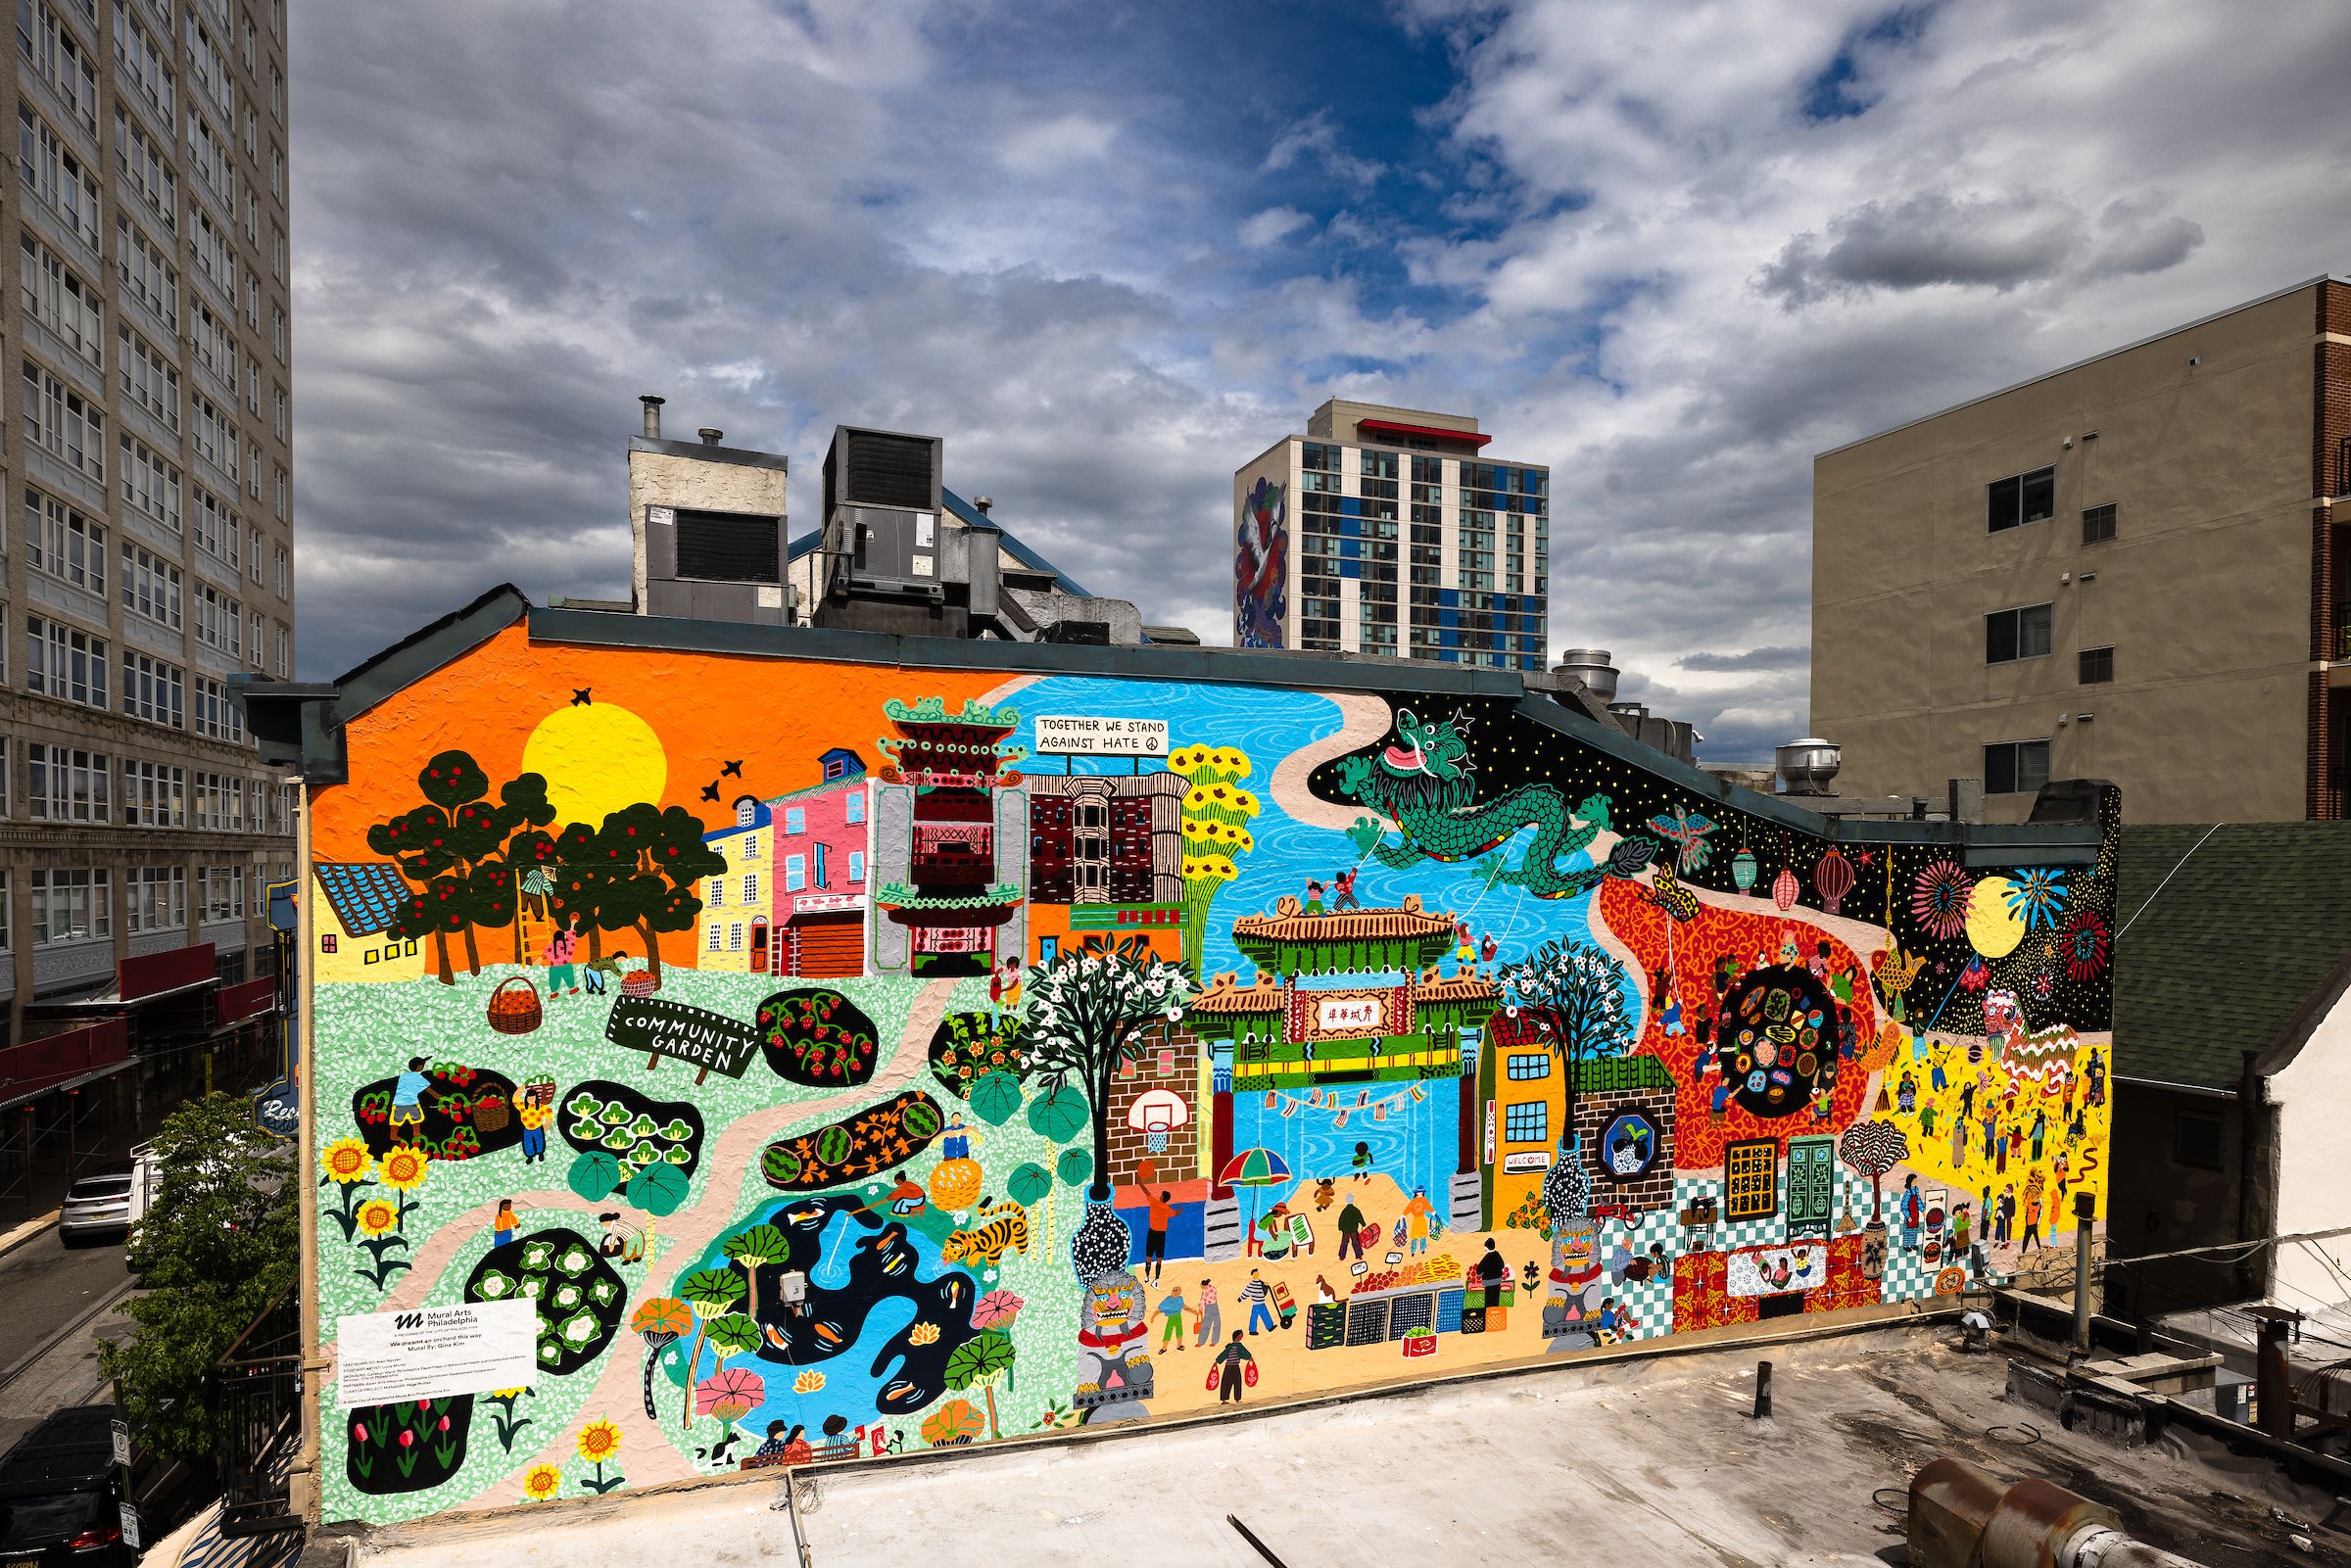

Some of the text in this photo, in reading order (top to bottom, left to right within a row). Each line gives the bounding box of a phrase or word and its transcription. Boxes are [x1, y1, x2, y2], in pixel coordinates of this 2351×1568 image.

[1040, 720, 1165, 733] TOGETHER WE STAND
[1040, 737, 1138, 749] AGAINST HATE
[625, 1017, 754, 1058] COMMUNITY
[652, 1035, 731, 1070] GARDEN
[1509, 1156, 1546, 1164] WELCOME
[427, 1310, 453, 1319] Mural
[427, 1315, 478, 1328] Philadelphia
